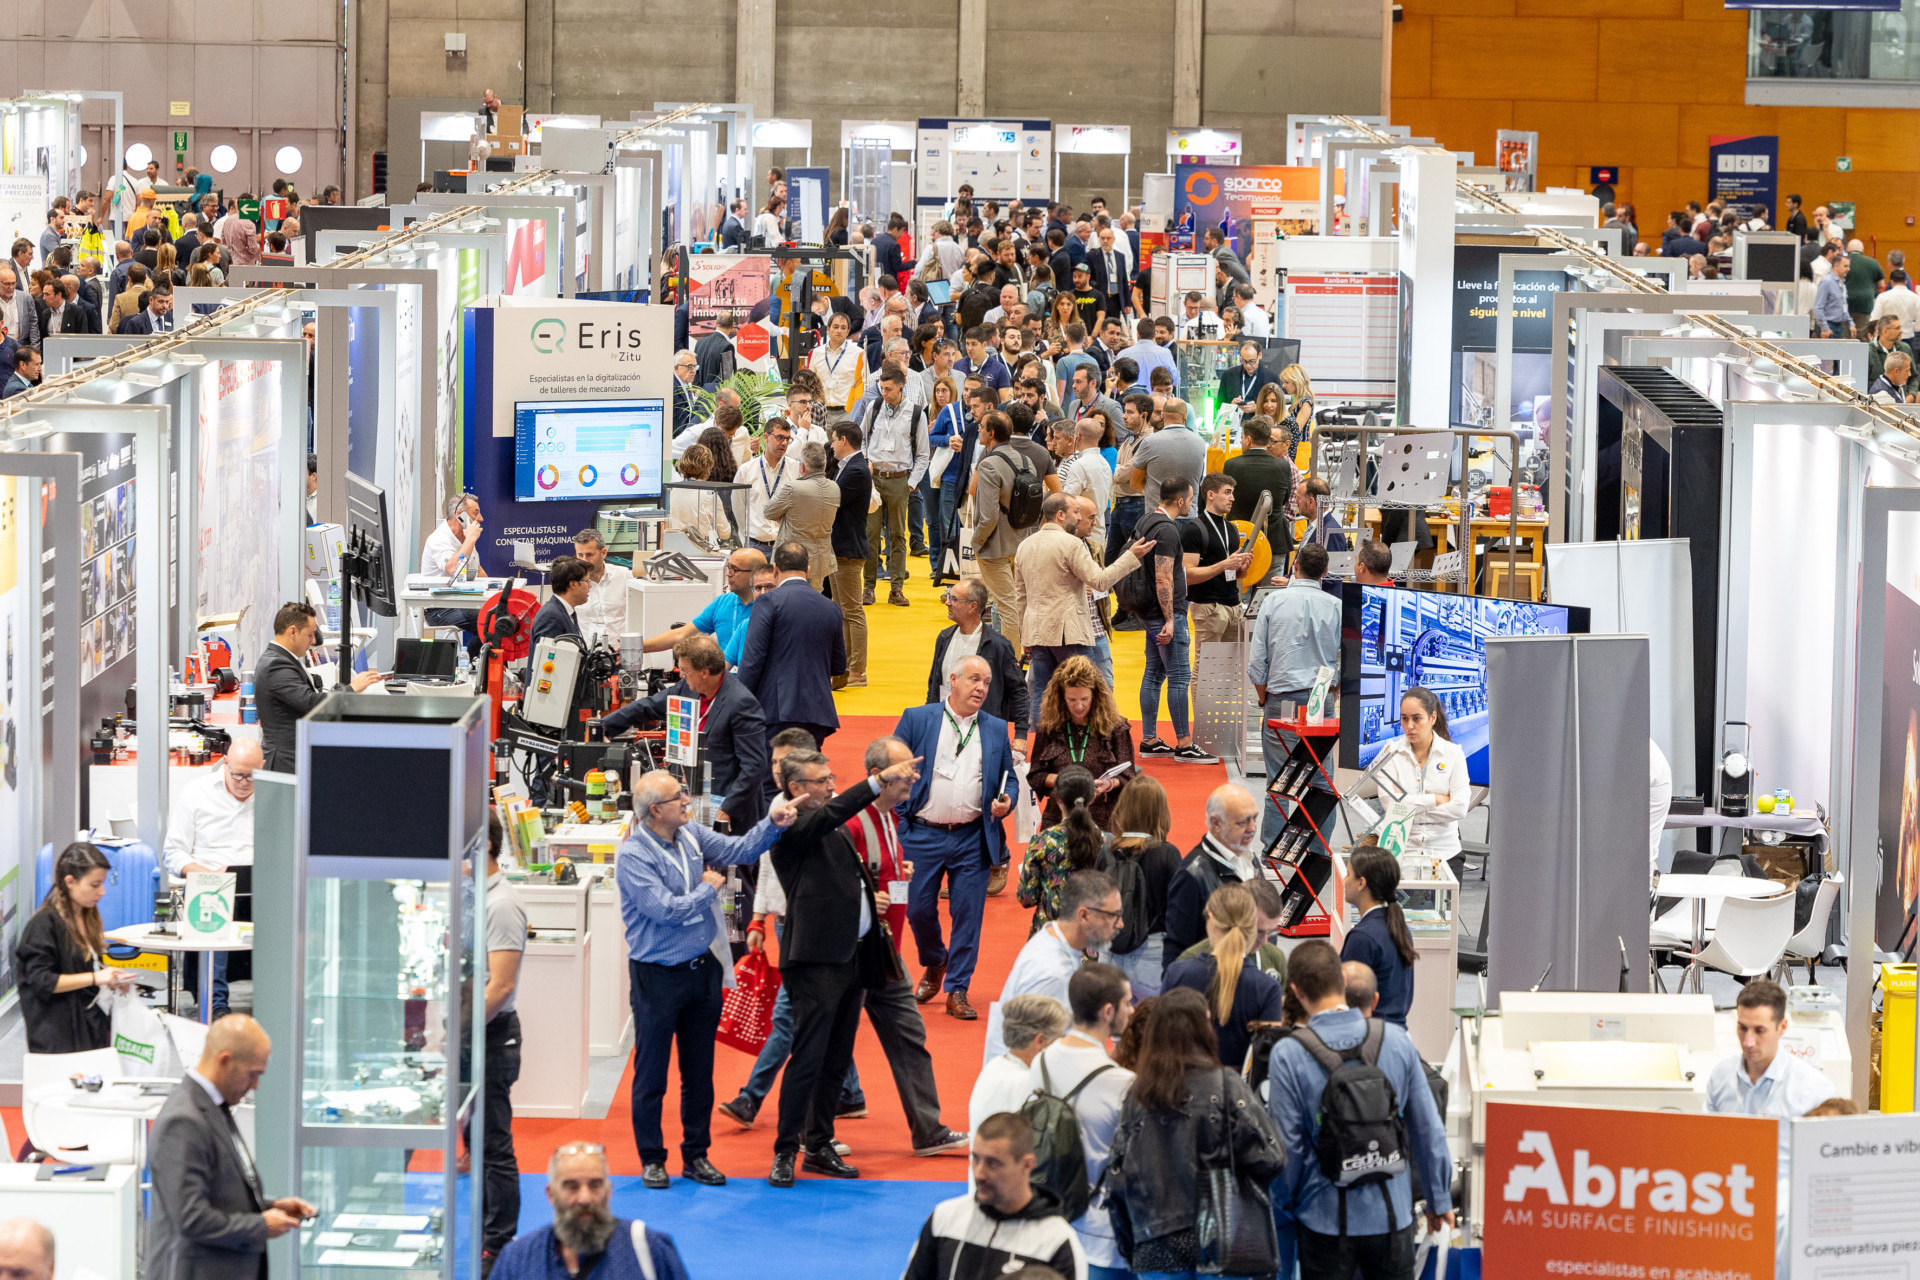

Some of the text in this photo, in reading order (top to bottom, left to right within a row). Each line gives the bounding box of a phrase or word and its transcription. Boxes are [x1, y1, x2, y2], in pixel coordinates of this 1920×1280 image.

[1224, 177, 1282, 193] sparco
[1224, 193, 1282, 201] Teamwork
[1457, 280, 1560, 291] Lleve la ficación de
[693, 296, 747, 307] Inspira tu
[1479, 295, 1538, 304] protos al
[693, 307, 748, 317] innovión
[1469, 307, 1546, 319] siguie nivel
[579, 322, 641, 349] Eris
[618, 352, 641, 361] Zitu
[529, 374, 575, 383] Especialistas
[595, 373, 641, 383] digitalización
[539, 386, 549, 394] de
[589, 385, 631, 393] mecanizado
[503, 526, 556, 535] ESPECIALISTAS
[536, 535, 576, 546] MÁQUINAS
[1820, 1141, 1878, 1158] Cambie
[1882, 1143, 1891, 1155] a
[1503, 1130, 1755, 1217] Abrast
[1502, 1207, 1753, 1241] AM SURFACE FINISHING
[1804, 1239, 1920, 1258] Comparativa piez
[1545, 1259, 1751, 1280] especialistas en acabados
